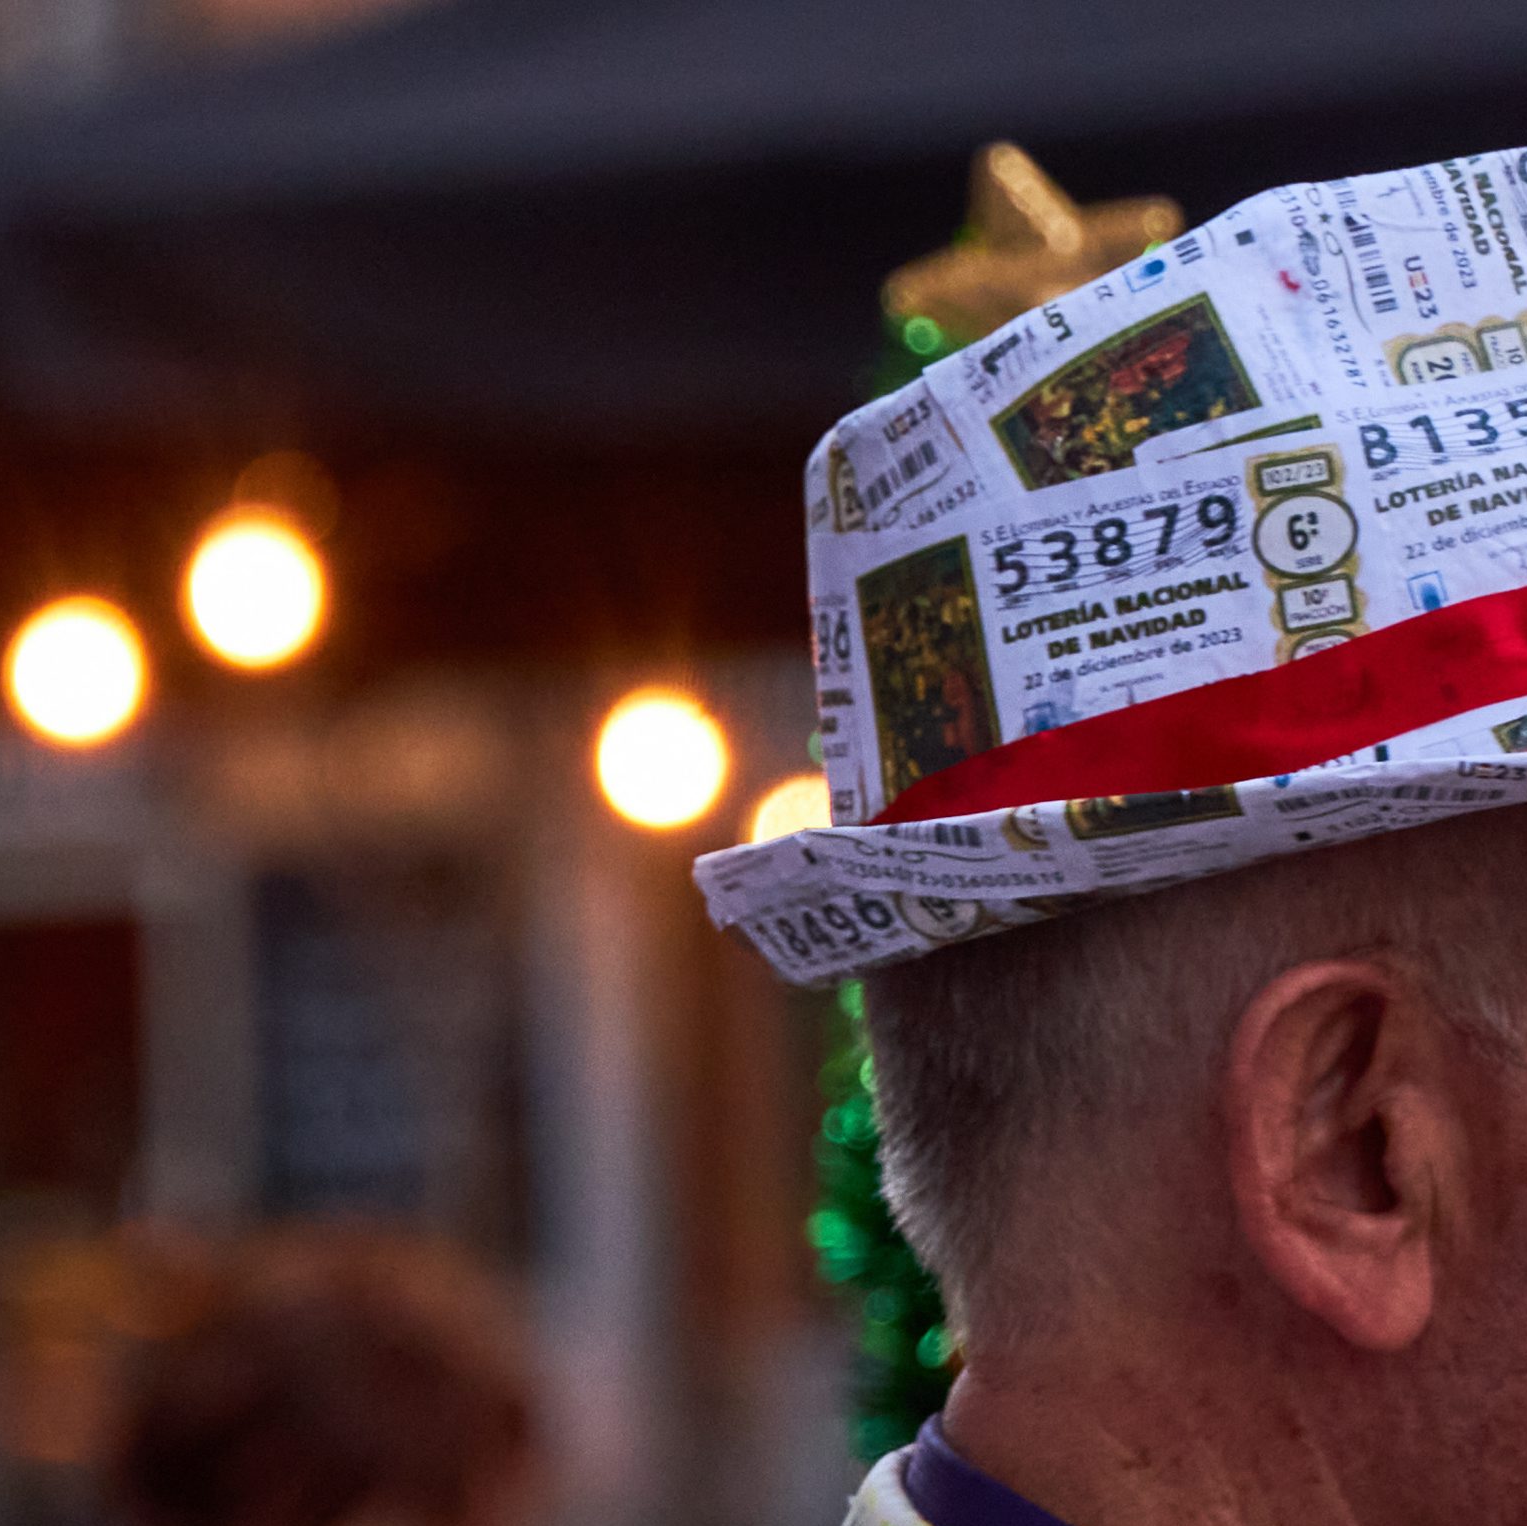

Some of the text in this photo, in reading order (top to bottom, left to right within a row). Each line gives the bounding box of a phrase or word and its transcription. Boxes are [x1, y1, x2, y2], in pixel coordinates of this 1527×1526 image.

[1452, 245, 1478, 289] 2023
[1372, 471, 1486, 515] LOTERÍA
[1427, 503, 1462, 527] DE
[992, 494, 1239, 595] 53879
[1402, 543, 1428, 561] 22
[1430, 533, 1456, 554] de
[1001, 571, 1250, 644] LOTERÍA NACIONAL
[1046, 607, 1207, 660] DE NAVIDAD
[1022, 627, 1243, 691] 22 de diciembre de 2023
